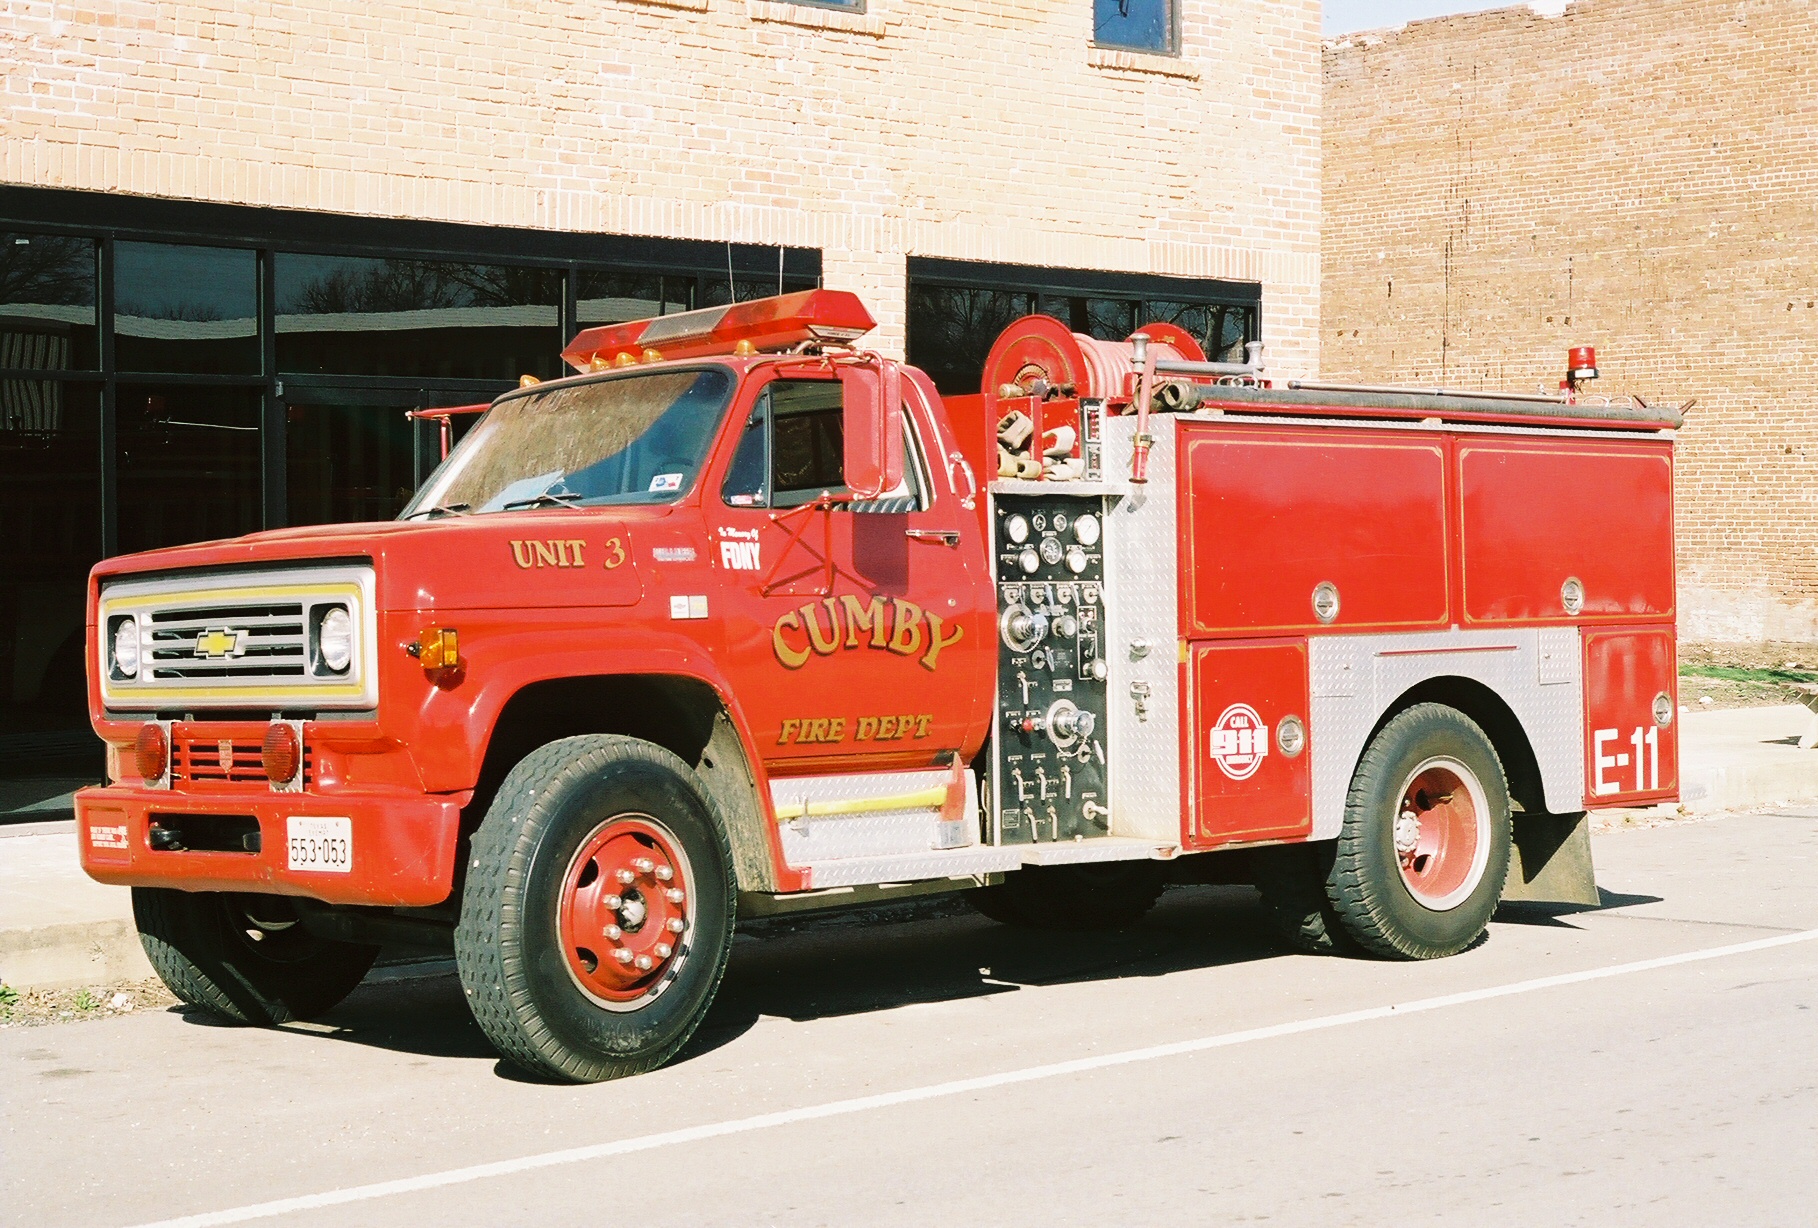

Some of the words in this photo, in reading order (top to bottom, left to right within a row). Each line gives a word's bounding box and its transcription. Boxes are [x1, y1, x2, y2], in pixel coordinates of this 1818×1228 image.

[509, 539, 587, 569] UNIT
[604, 537, 626, 570] 3
[720, 541, 760, 570] FDNY
[772, 594, 965, 672] CUMBY
[776, 717, 847, 746] FIRE
[1229, 715, 1250, 728] CALL
[1210, 727, 1268, 757] 911
[1594, 725, 1659, 797] E-11
